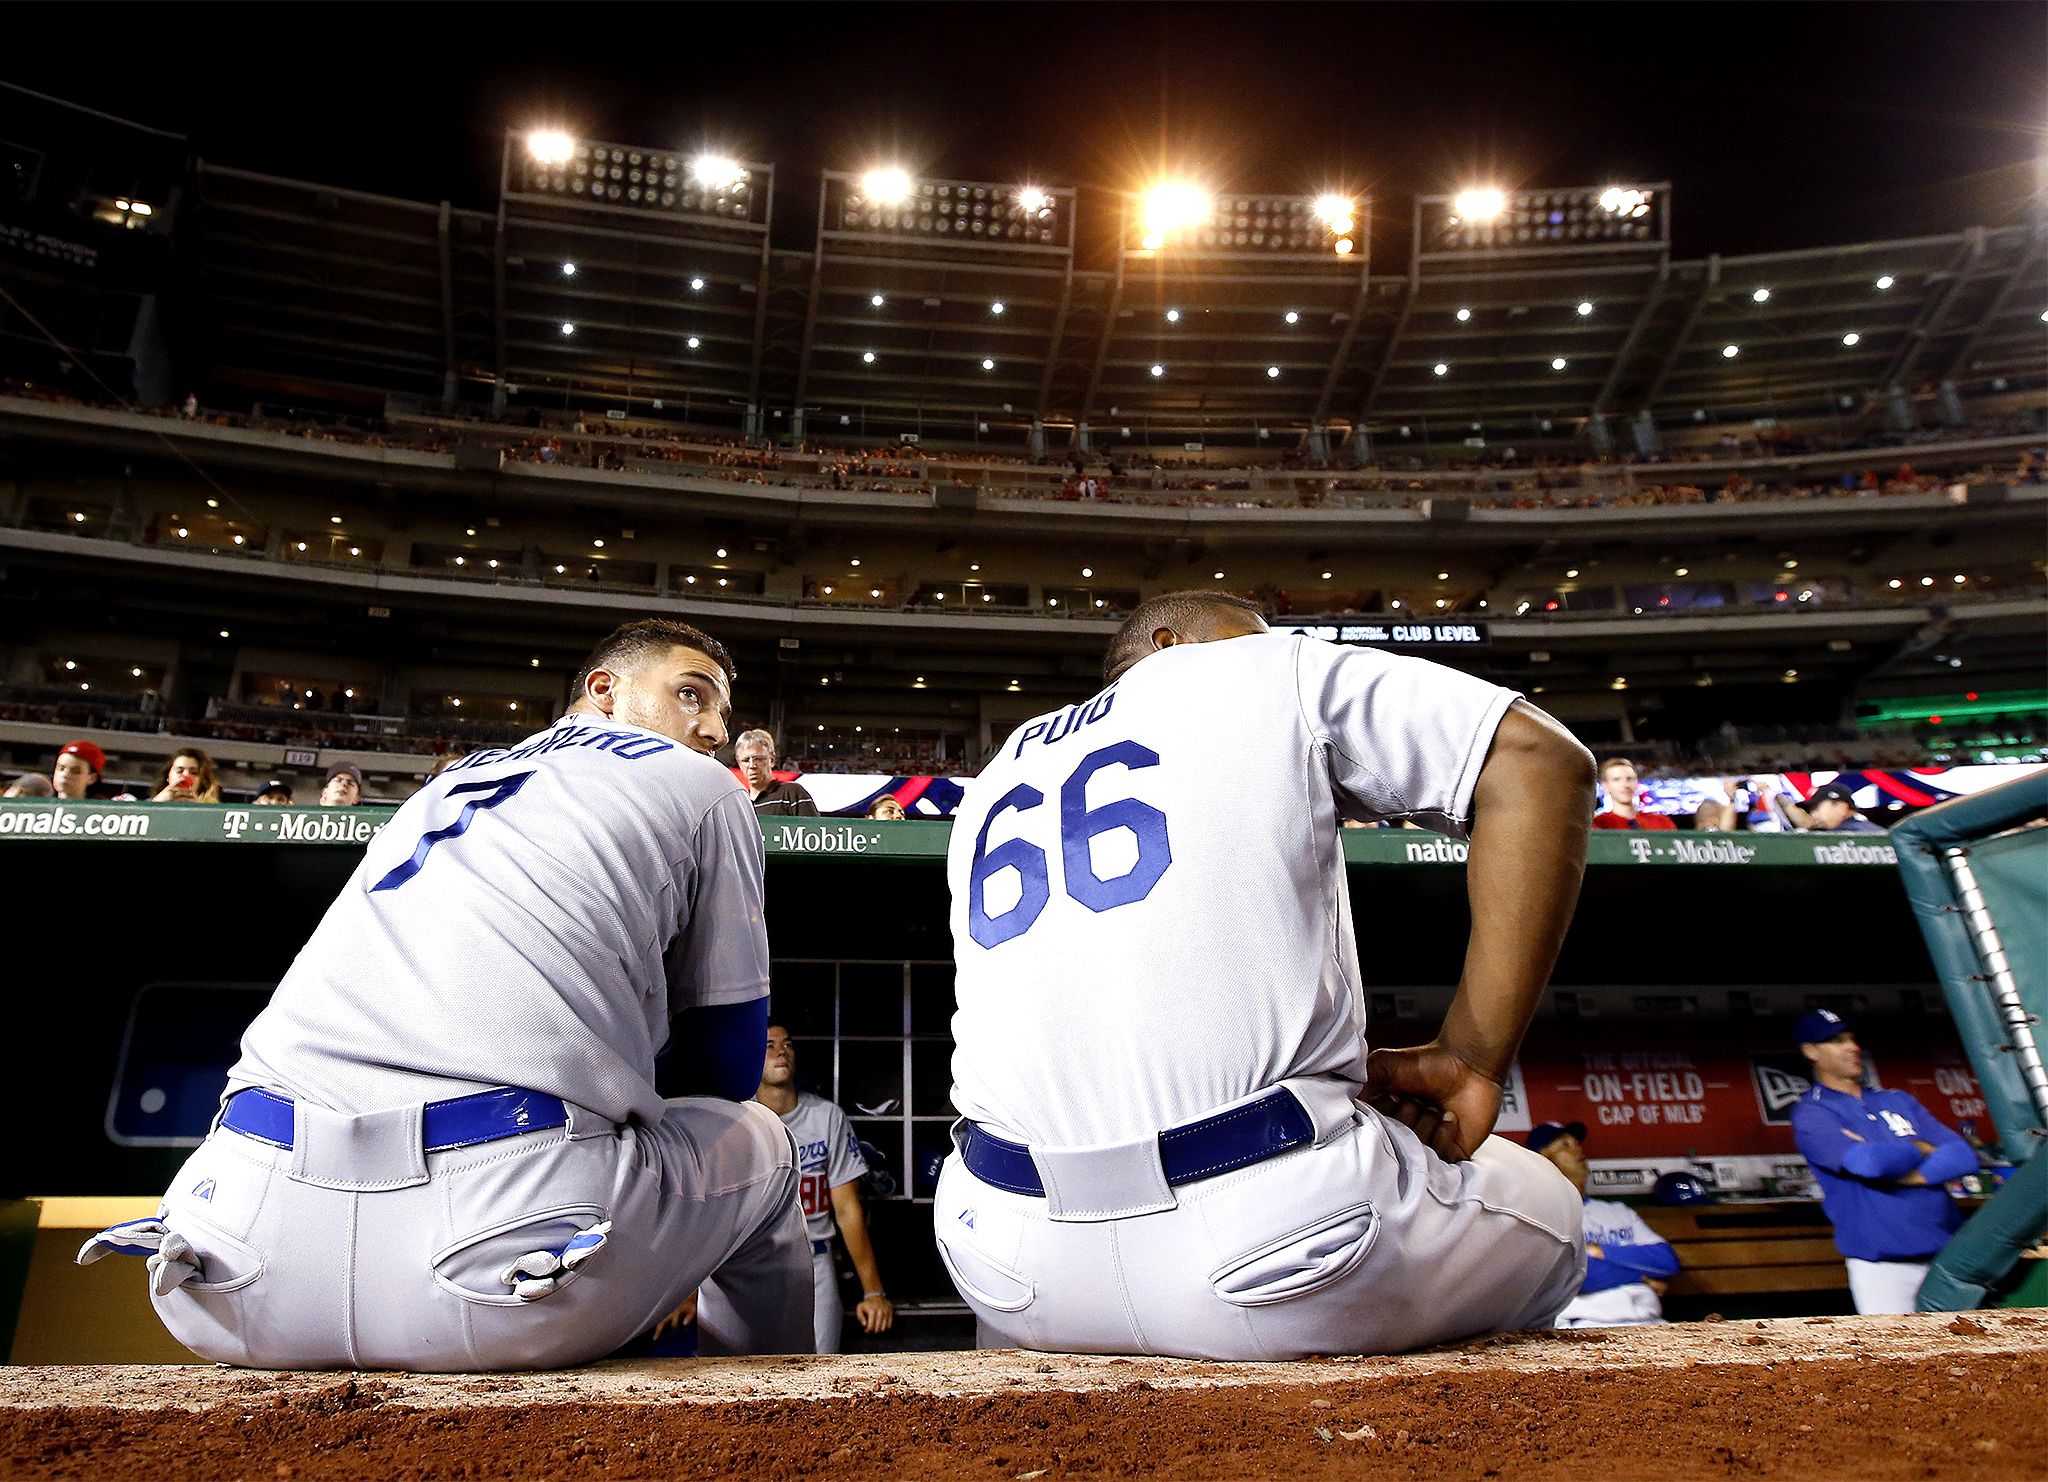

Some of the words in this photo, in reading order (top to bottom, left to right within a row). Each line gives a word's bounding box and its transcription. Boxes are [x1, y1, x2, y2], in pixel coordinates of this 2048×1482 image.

[1391, 626, 1431, 641] CLUB
[1433, 626, 1479, 641] LEVEL
[1013, 692, 1116, 760] PUIG
[370, 770, 536, 893] 7
[967, 740, 1172, 950] 66
[1406, 839, 1469, 862] natio
[1583, 1071, 1704, 1102] ON-FIELD
[1597, 1104, 1635, 1125] CAP
[1636, 1104, 1660, 1124] OF
